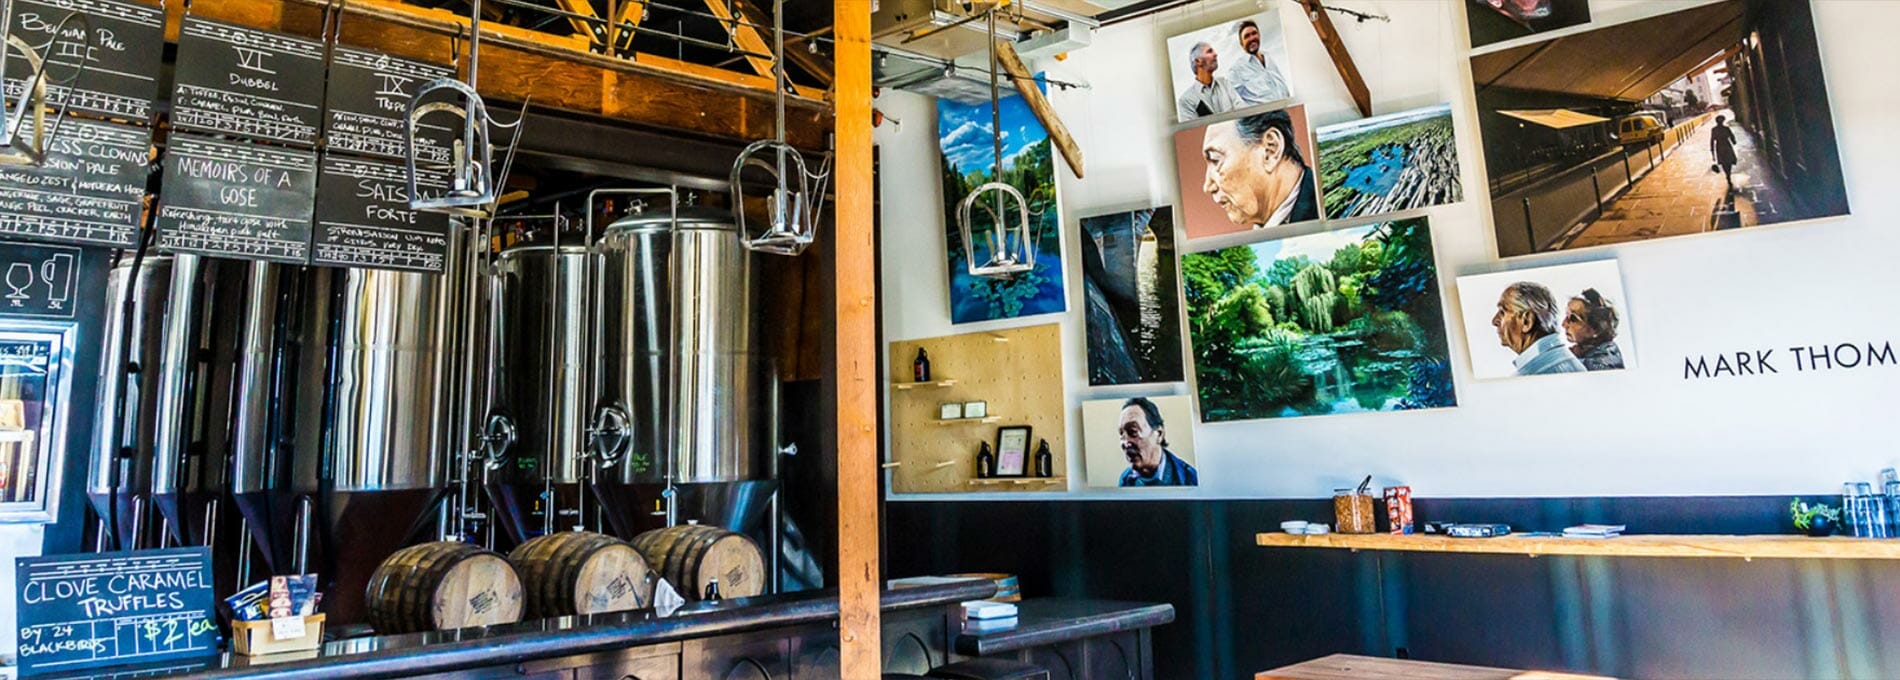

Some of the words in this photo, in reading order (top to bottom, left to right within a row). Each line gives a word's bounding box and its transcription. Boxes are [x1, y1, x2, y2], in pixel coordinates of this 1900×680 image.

[231, 45, 277, 75] VI
[229, 72, 279, 92] DUBBEL
[373, 72, 414, 98] IX
[375, 97, 407, 113] TRIPE
[88, 144, 149, 167] CLOWNS
[86, 161, 120, 175] PALE
[177, 157, 249, 183] MEMOIRS
[254, 167, 273, 185] OF
[276, 171, 292, 188] A
[220, 187, 258, 208] GOSE
[366, 204, 418, 224] FORTE
[1684, 348, 1778, 380] MARK
[1789, 340, 1897, 372] THOM
[23, 576, 100, 605] CLOVE
[107, 570, 212, 594] CARAMEL
[77, 591, 184, 619] TRUFFLES
[52, 626, 74, 638] 24
[20, 639, 106, 657] BLACKBIRDS
